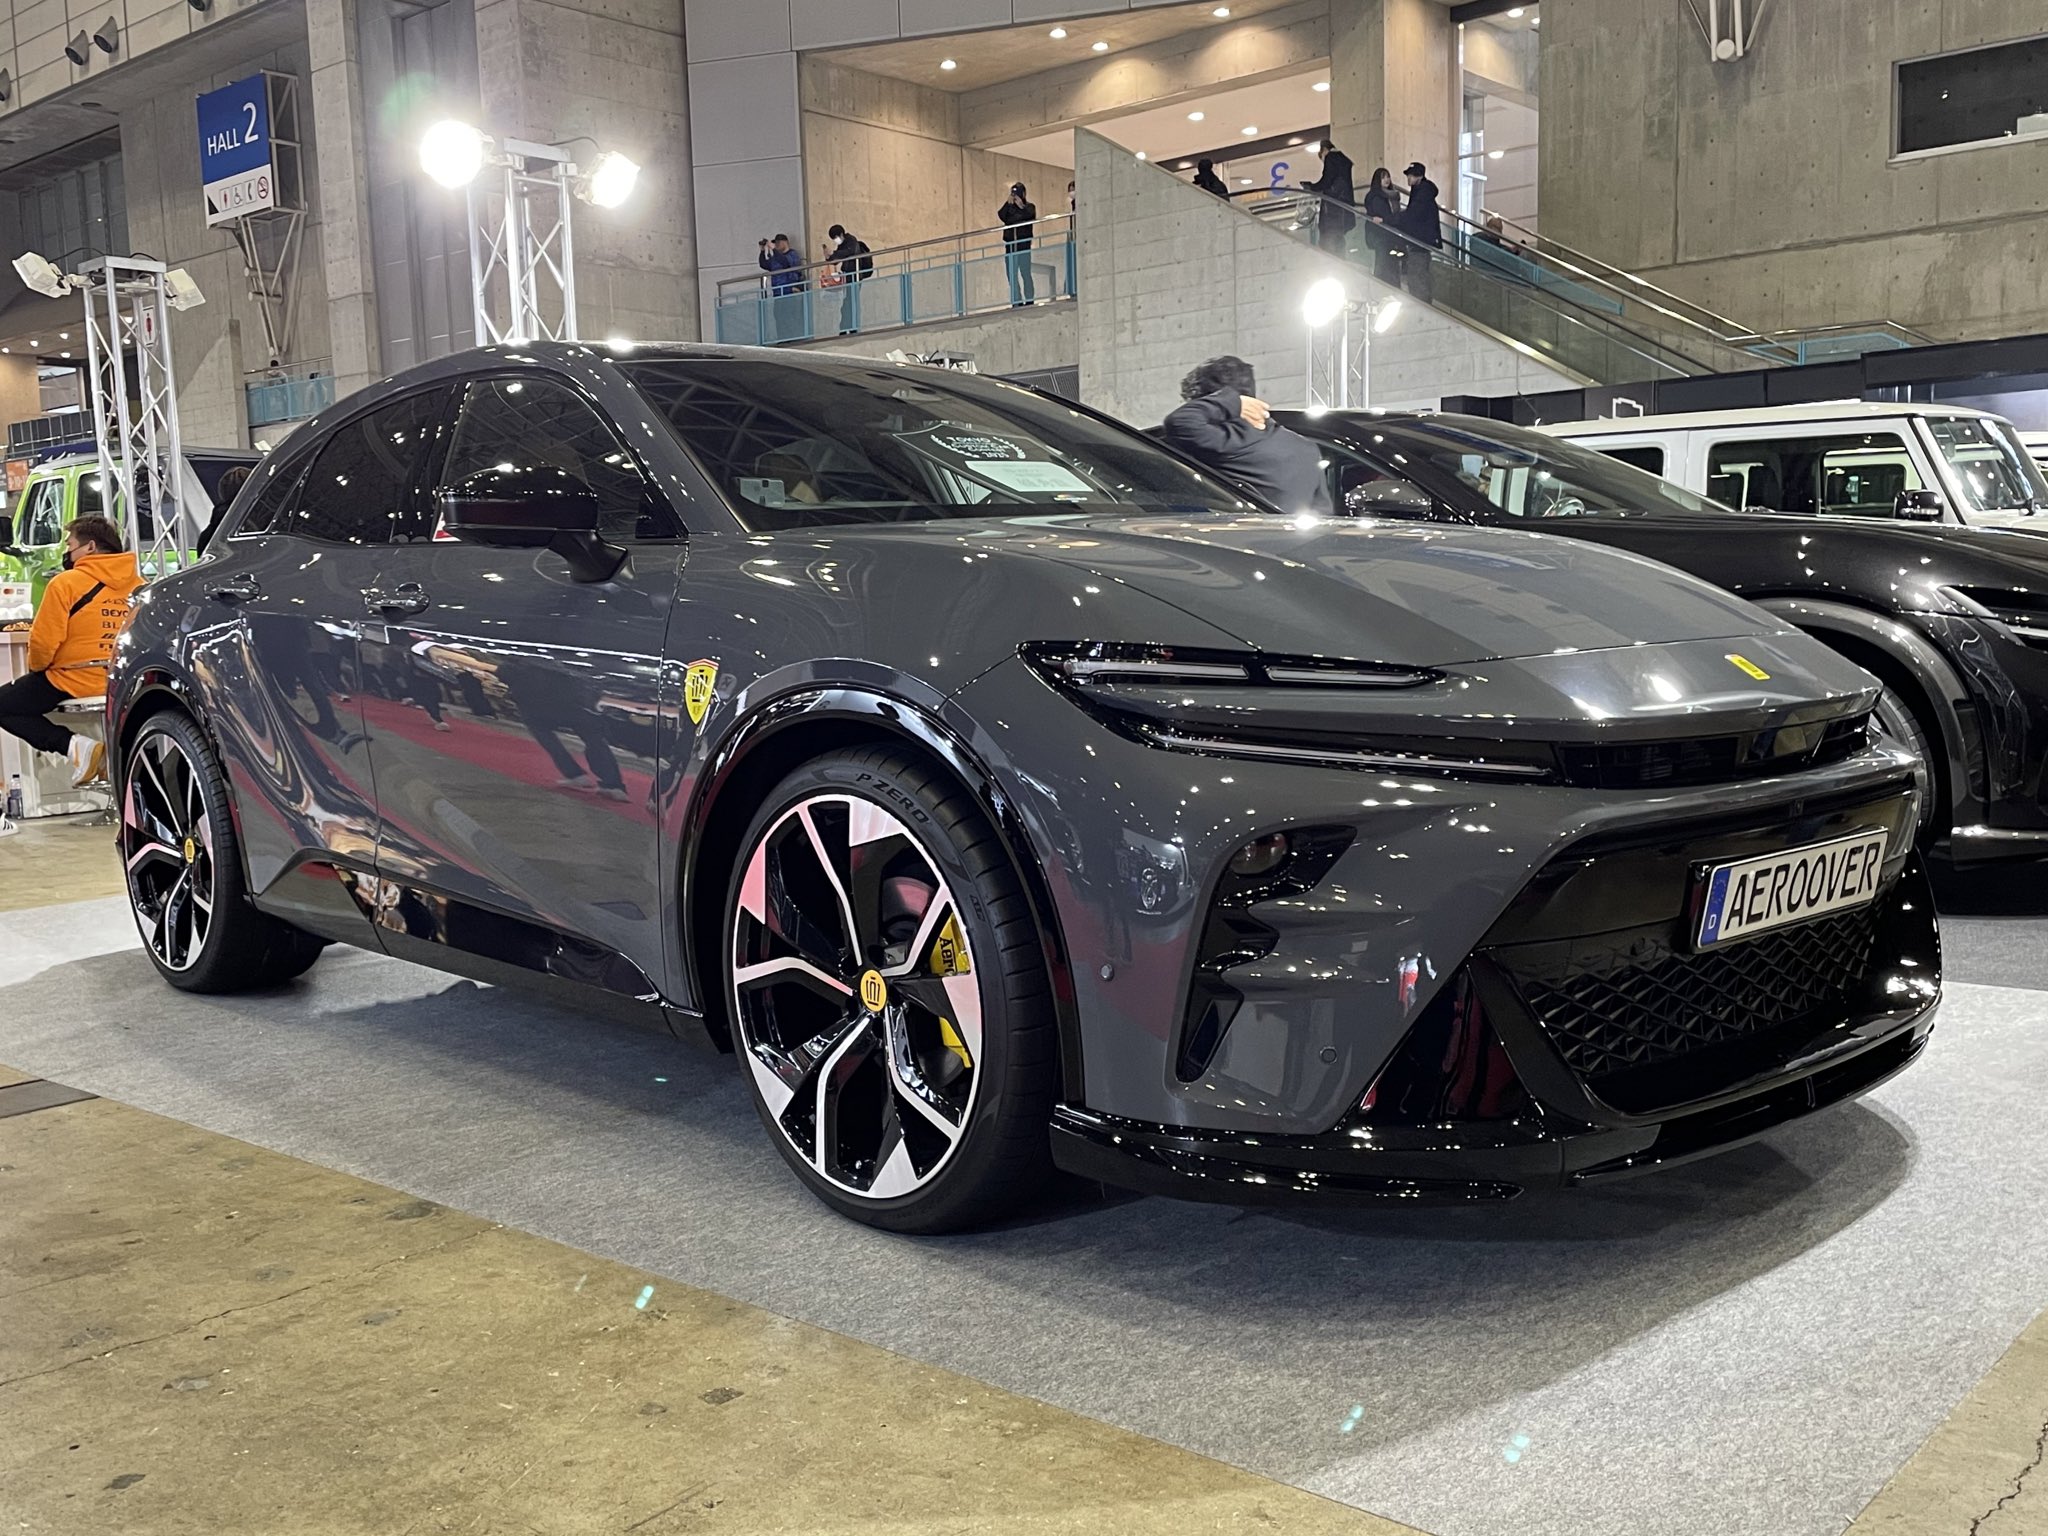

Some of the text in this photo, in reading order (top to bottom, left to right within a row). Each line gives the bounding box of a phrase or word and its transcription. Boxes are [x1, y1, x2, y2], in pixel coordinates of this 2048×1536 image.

[207, 102, 259, 156] HALL 2
[101, 608, 129, 618] BEYO
[856, 773, 930, 824] P ZERO
[1724, 841, 1881, 931] AEROOVER
[1707, 913, 1717, 930] D
